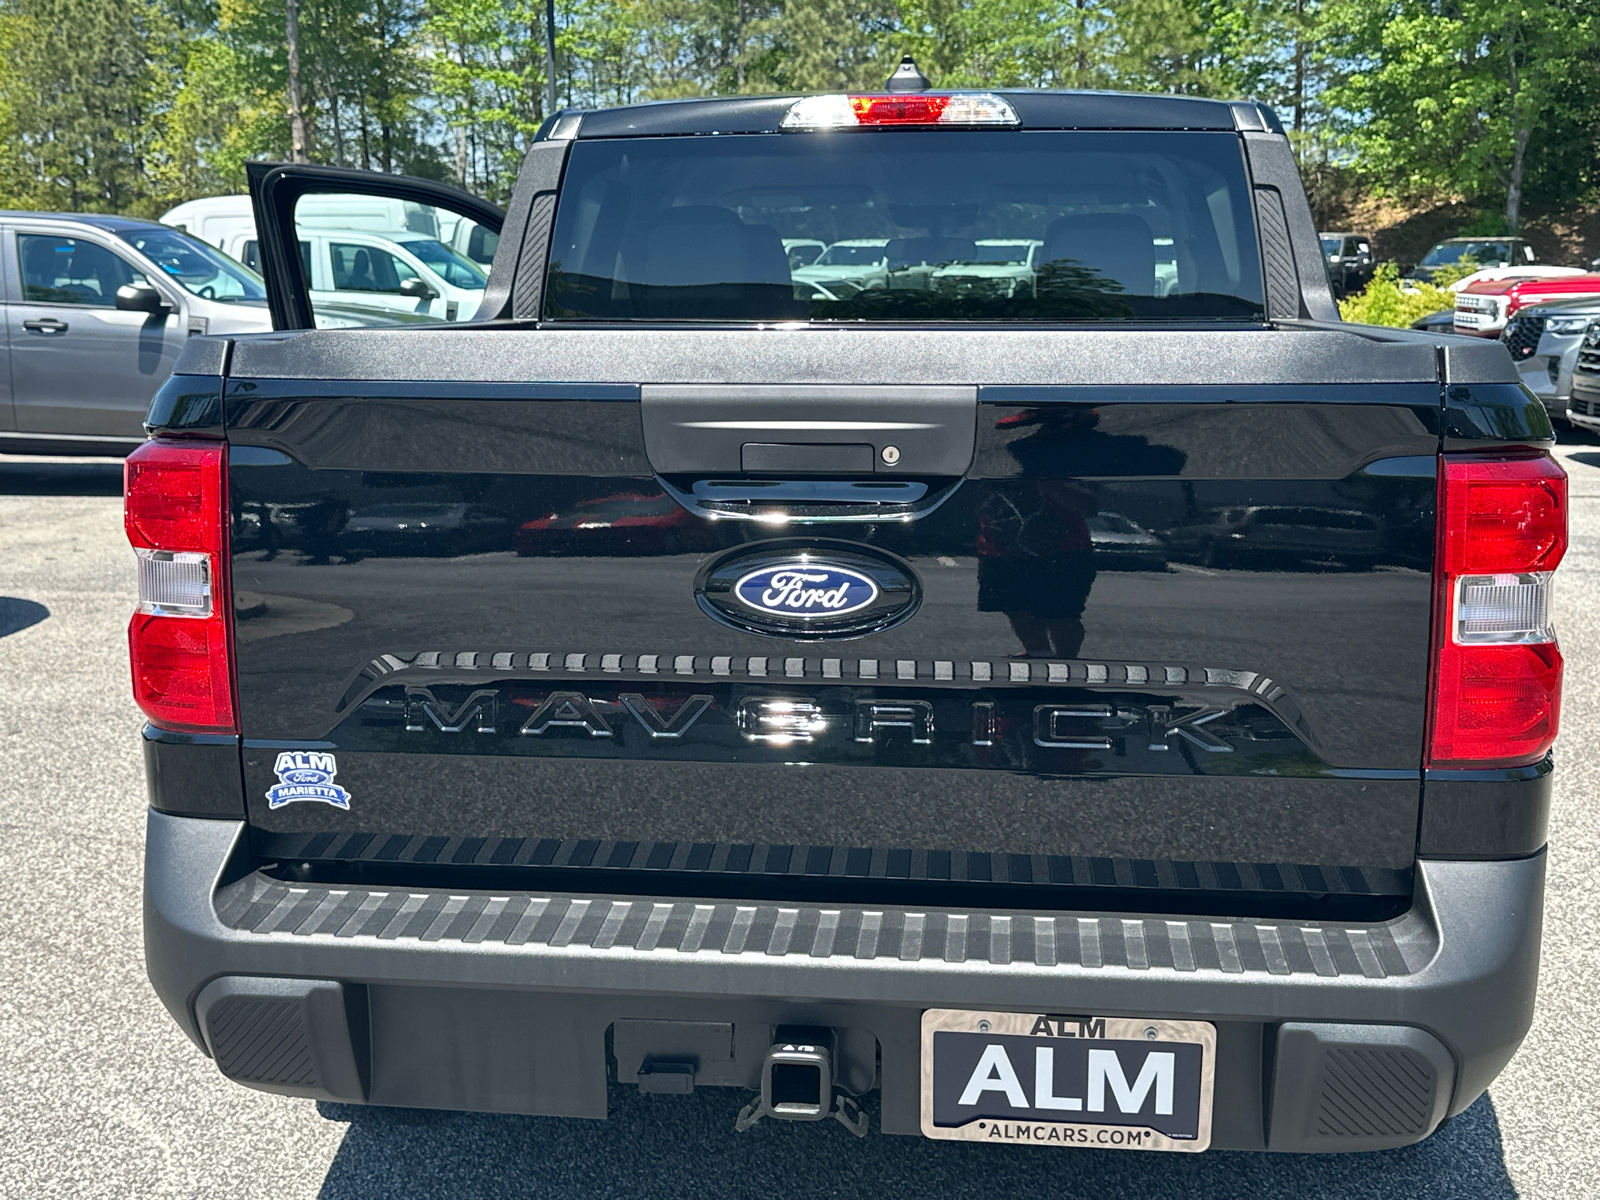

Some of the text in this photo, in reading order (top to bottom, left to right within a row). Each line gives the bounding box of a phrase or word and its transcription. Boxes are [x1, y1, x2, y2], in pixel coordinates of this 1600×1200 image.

[762, 571, 850, 608] Ford
[404, 687, 1235, 754] MAVERICK
[277, 754, 333, 773] ALM
[293, 772, 319, 783] Ford
[278, 786, 338, 798] MARIETTA
[1030, 1016, 1106, 1038] ALM
[957, 1044, 1175, 1115] ALM
[988, 1123, 1142, 1146] ALMCARS.COM
